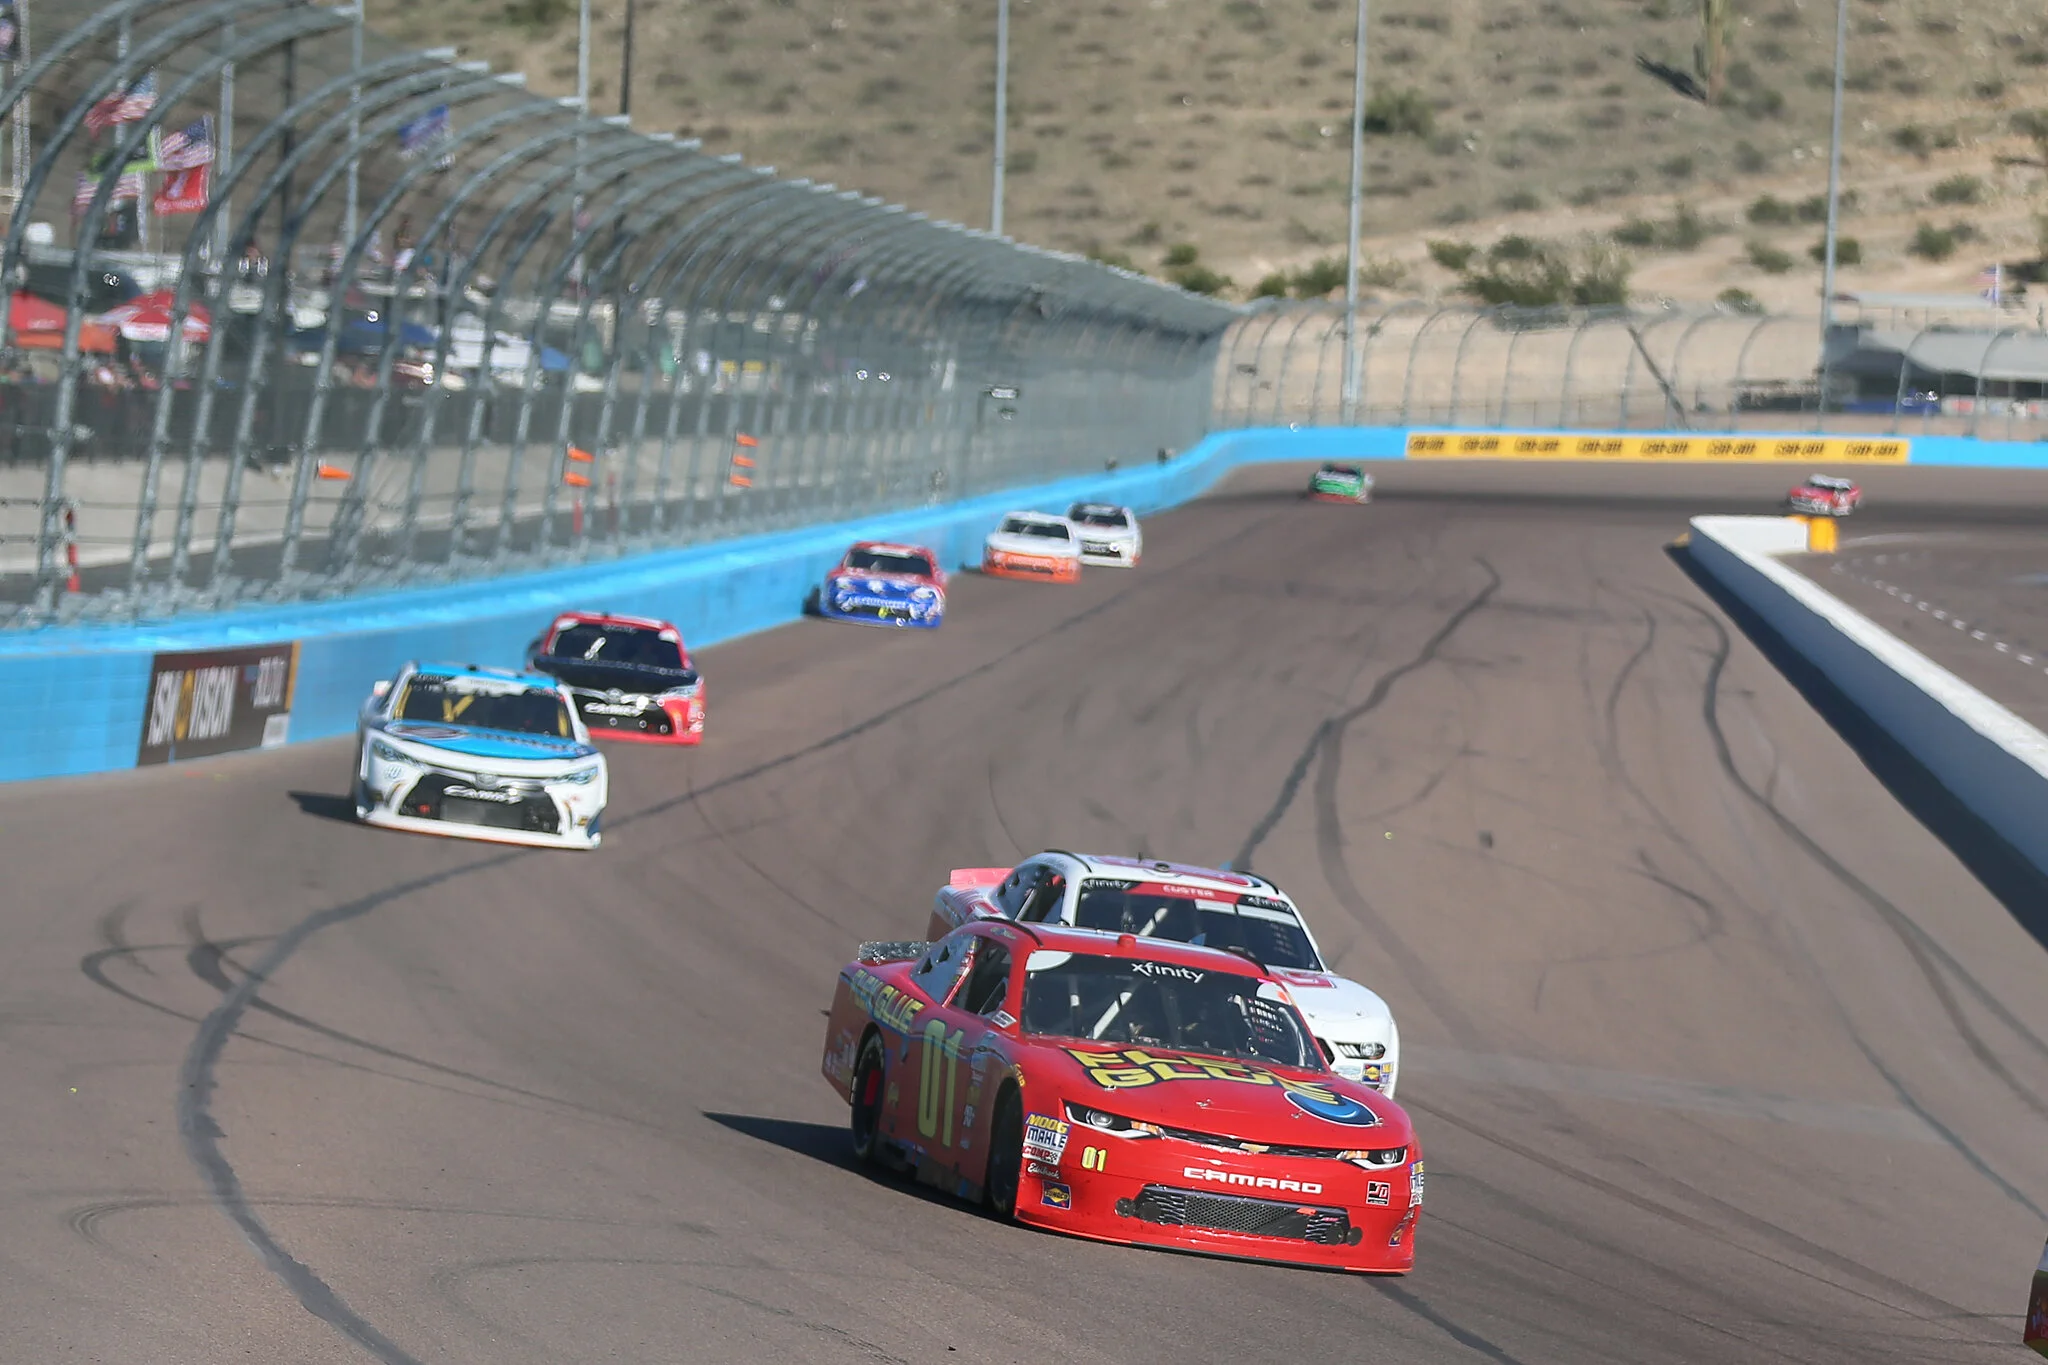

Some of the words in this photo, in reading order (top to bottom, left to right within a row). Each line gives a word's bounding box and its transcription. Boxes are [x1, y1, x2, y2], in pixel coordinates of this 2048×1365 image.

[1130, 961, 1205, 983] xfinity
[917, 1018, 965, 1148] 01
[1026, 1113, 1070, 1135] MOOG
[1026, 1127, 1067, 1149] MAHLE
[1081, 1145, 1108, 1172] 01
[1183, 1166, 1323, 1194] CAMARO
